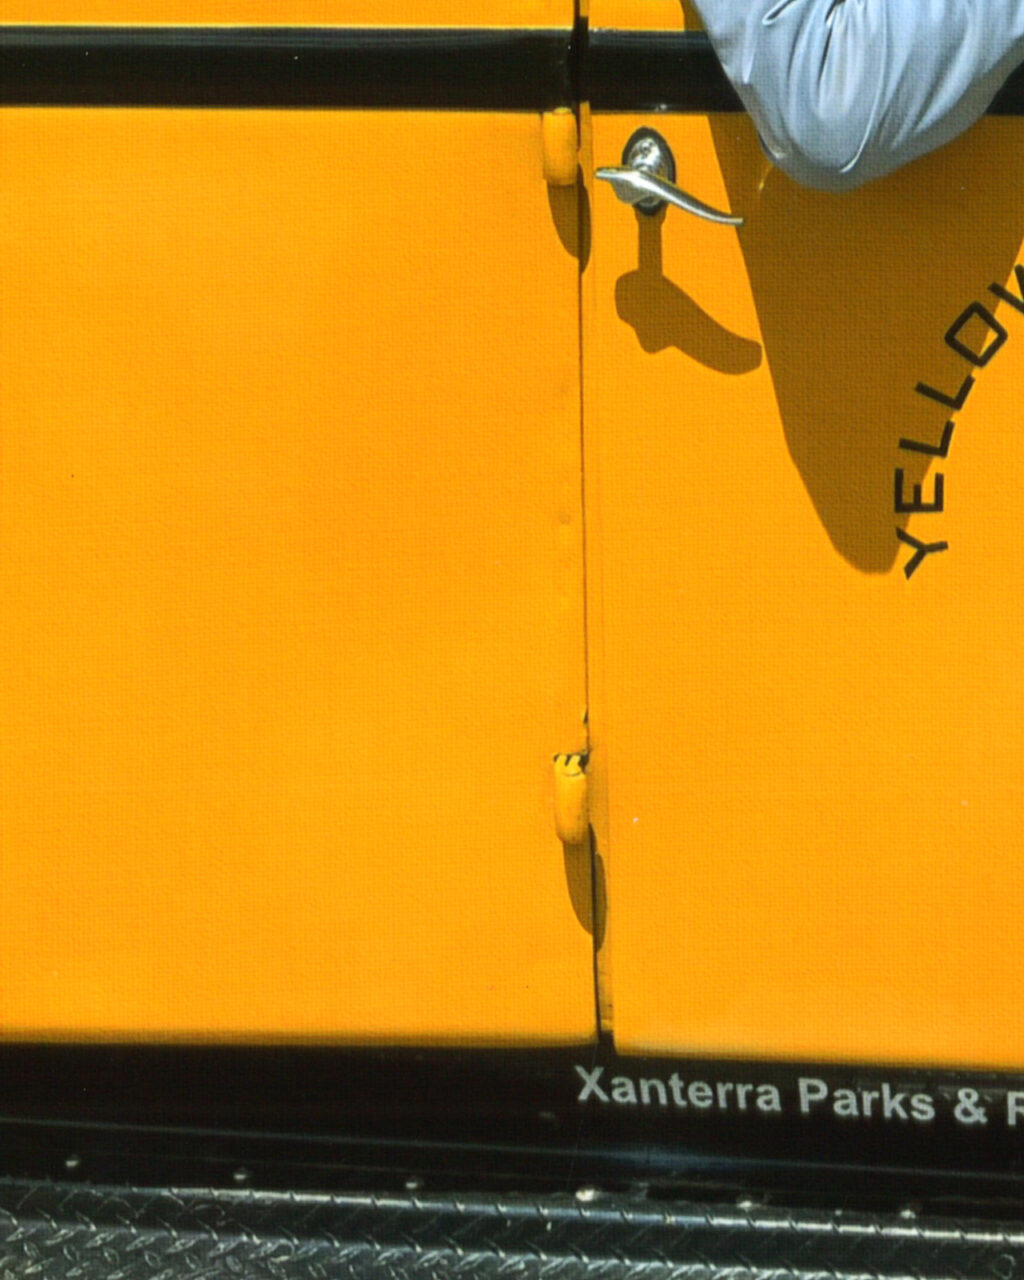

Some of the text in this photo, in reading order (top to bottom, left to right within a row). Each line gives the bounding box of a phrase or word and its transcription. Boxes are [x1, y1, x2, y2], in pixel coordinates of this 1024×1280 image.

[574, 1065, 783, 1112] Xanterra
[798, 1077, 936, 1121] Parks
[953, 1087, 988, 1124] &
